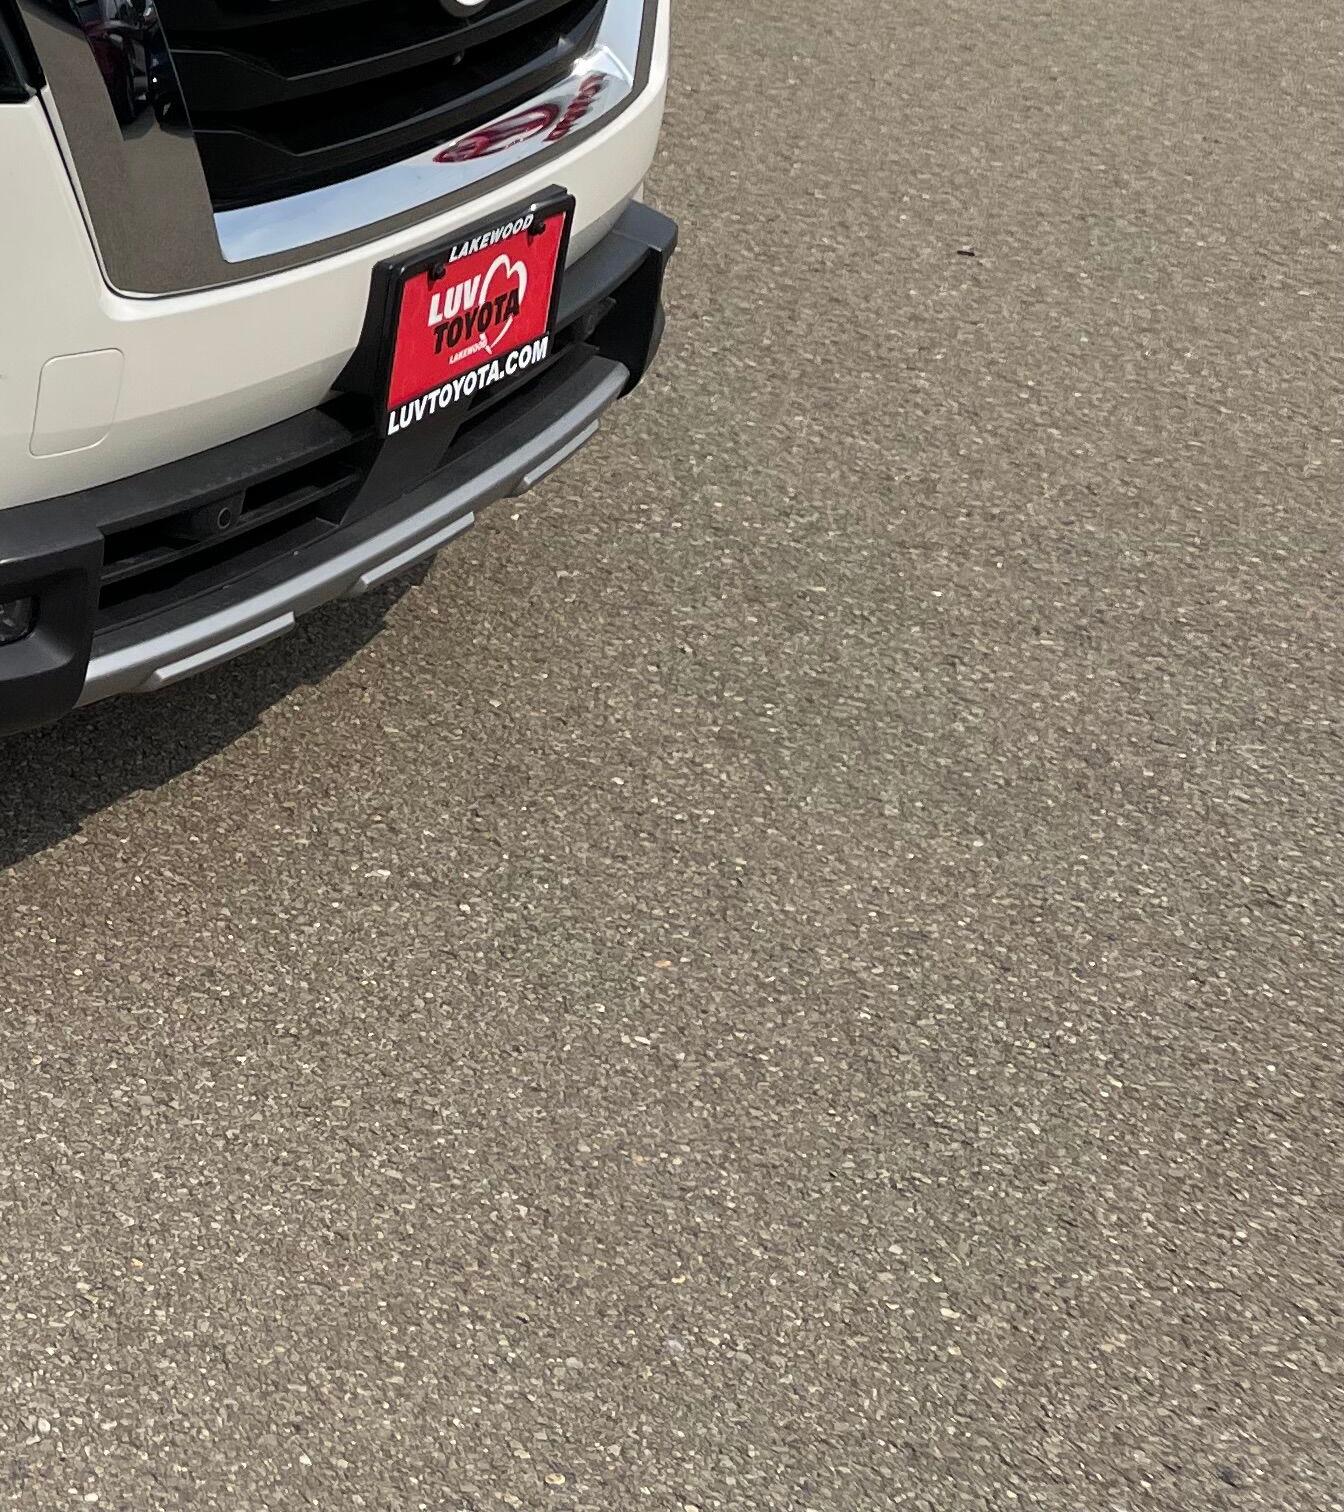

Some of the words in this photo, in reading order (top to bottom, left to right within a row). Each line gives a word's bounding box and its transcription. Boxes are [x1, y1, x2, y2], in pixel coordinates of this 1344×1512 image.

[449, 214, 535, 263] LAKEWOOD
[427, 274, 482, 327] LUV
[433, 288, 520, 354] TOYOTA
[387, 336, 549, 436] LUVTOYOTA.COM
